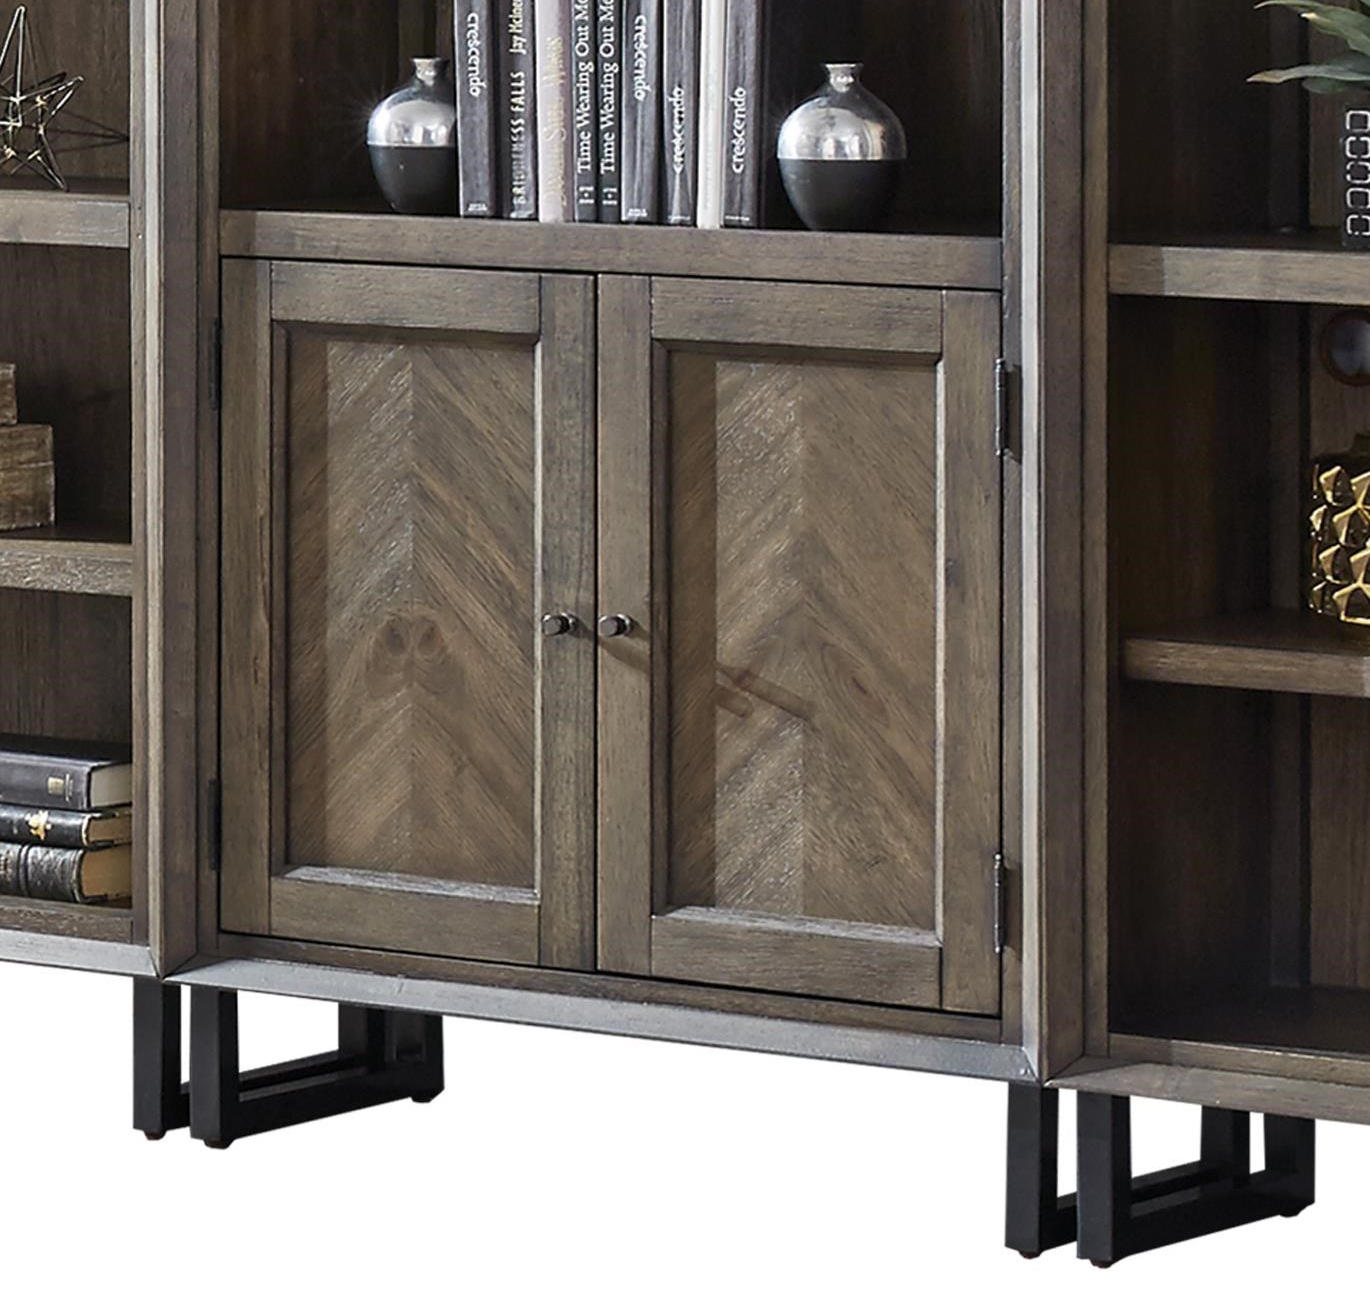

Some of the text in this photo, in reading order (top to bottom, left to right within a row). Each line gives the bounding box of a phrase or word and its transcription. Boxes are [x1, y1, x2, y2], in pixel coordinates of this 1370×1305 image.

[467, 12, 487, 97] crescendo
[509, 36, 527, 56] Jay
[575, 25, 590, 57] Out
[599, 26, 615, 58] Out
[633, 14, 652, 101] crescendo
[509, 71, 526, 113] FALLS
[576, 61, 594, 129] Wearing
[600, 62, 619, 130] Wearing
[576, 131, 592, 175] Time
[600, 131, 616, 175] Time
[668, 86, 685, 175] crescendo
[728, 86, 747, 174] crescendo
